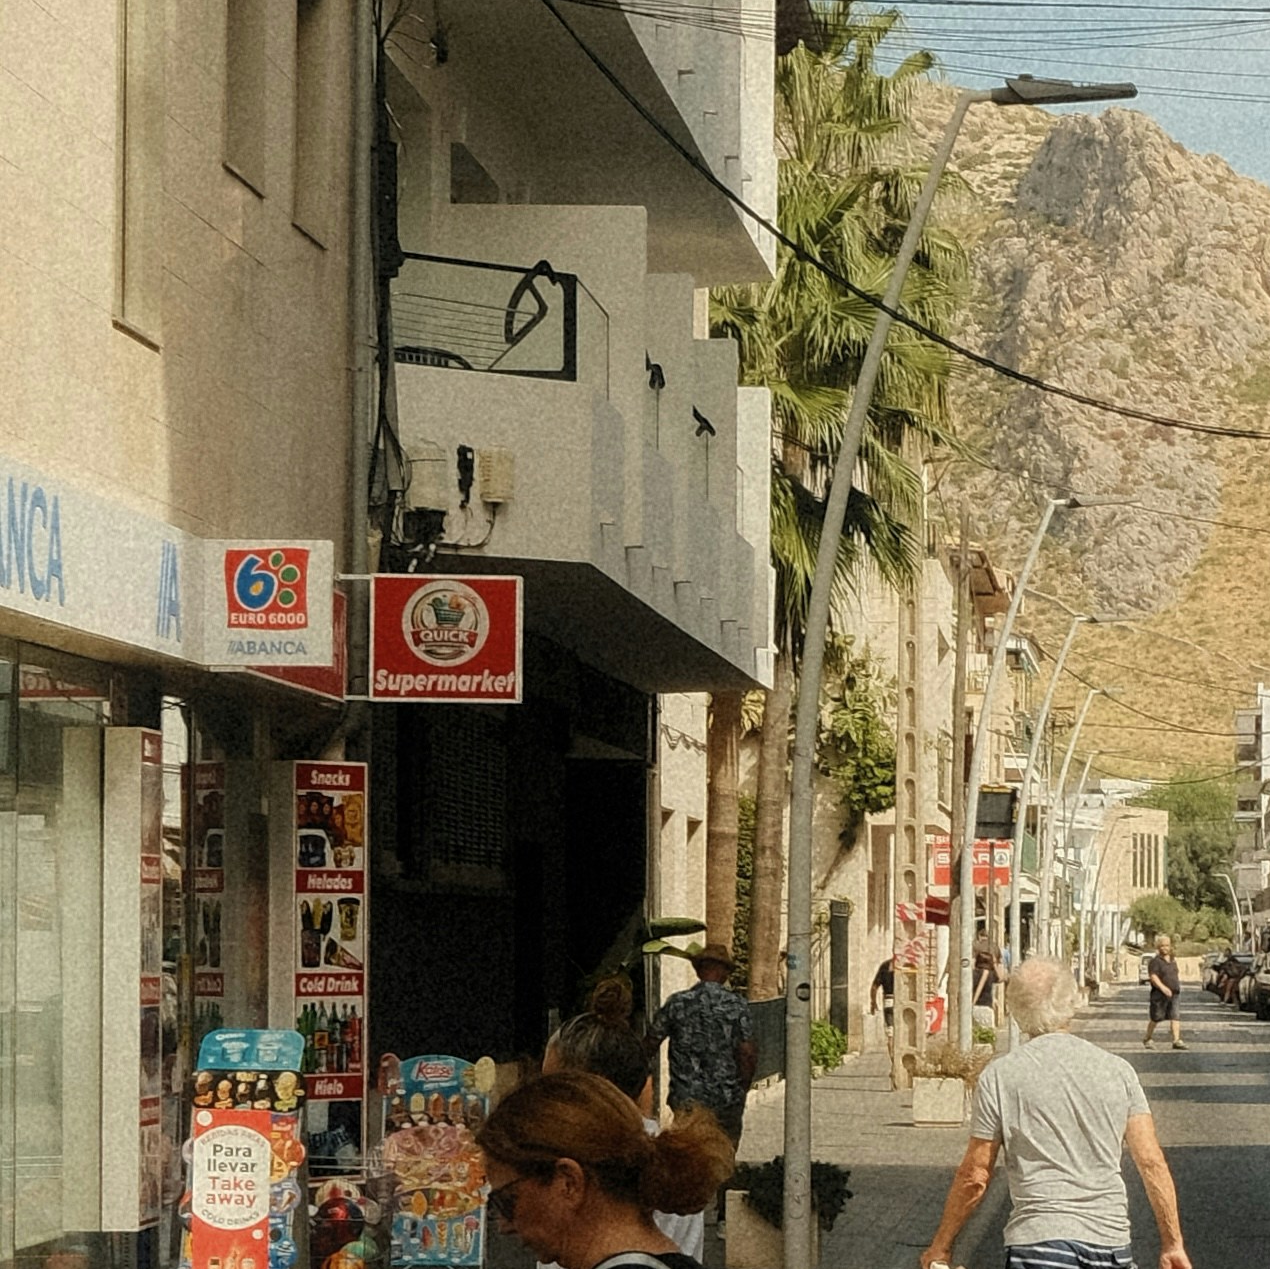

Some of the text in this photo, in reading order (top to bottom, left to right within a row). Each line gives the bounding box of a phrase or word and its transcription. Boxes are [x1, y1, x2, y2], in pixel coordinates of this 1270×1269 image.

[0, 476, 65, 607] NCA
[230, 612, 306, 625] EURO 6000
[420, 629, 469, 644] QUICK
[374, 668, 516, 696] Supermarket
[310, 769, 351, 787] Snacks
[307, 873, 354, 891] Helados
[299, 975, 360, 993] Cold Drink
[314, 1077, 344, 1096] Hielo
[212, 1143, 253, 1158] Para
[207, 1158, 257, 1173] llevar
[207, 1176, 256, 1191] Take
[205, 1193, 257, 1208] away
[201, 1208, 225, 1224] COLD
